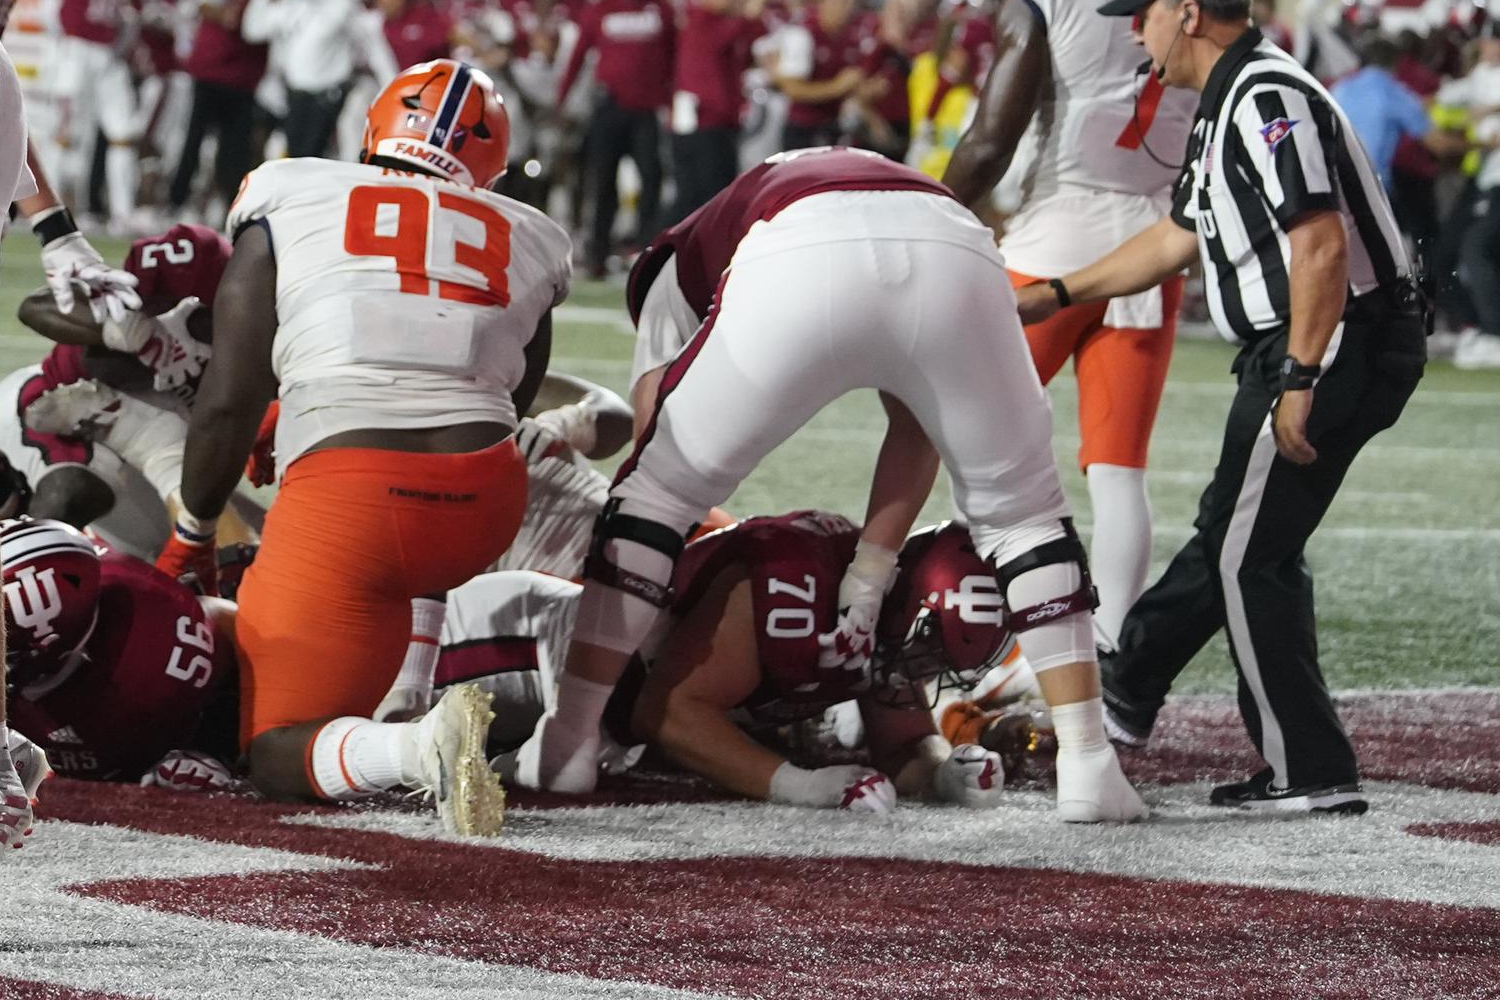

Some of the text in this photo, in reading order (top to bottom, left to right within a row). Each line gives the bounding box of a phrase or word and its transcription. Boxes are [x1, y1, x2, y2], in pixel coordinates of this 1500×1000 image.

[140, 238, 195, 269] 2
[344, 185, 512, 309] 93
[2, 565, 63, 639] IU
[765, 573, 817, 639] 70
[164, 614, 216, 689] 56
